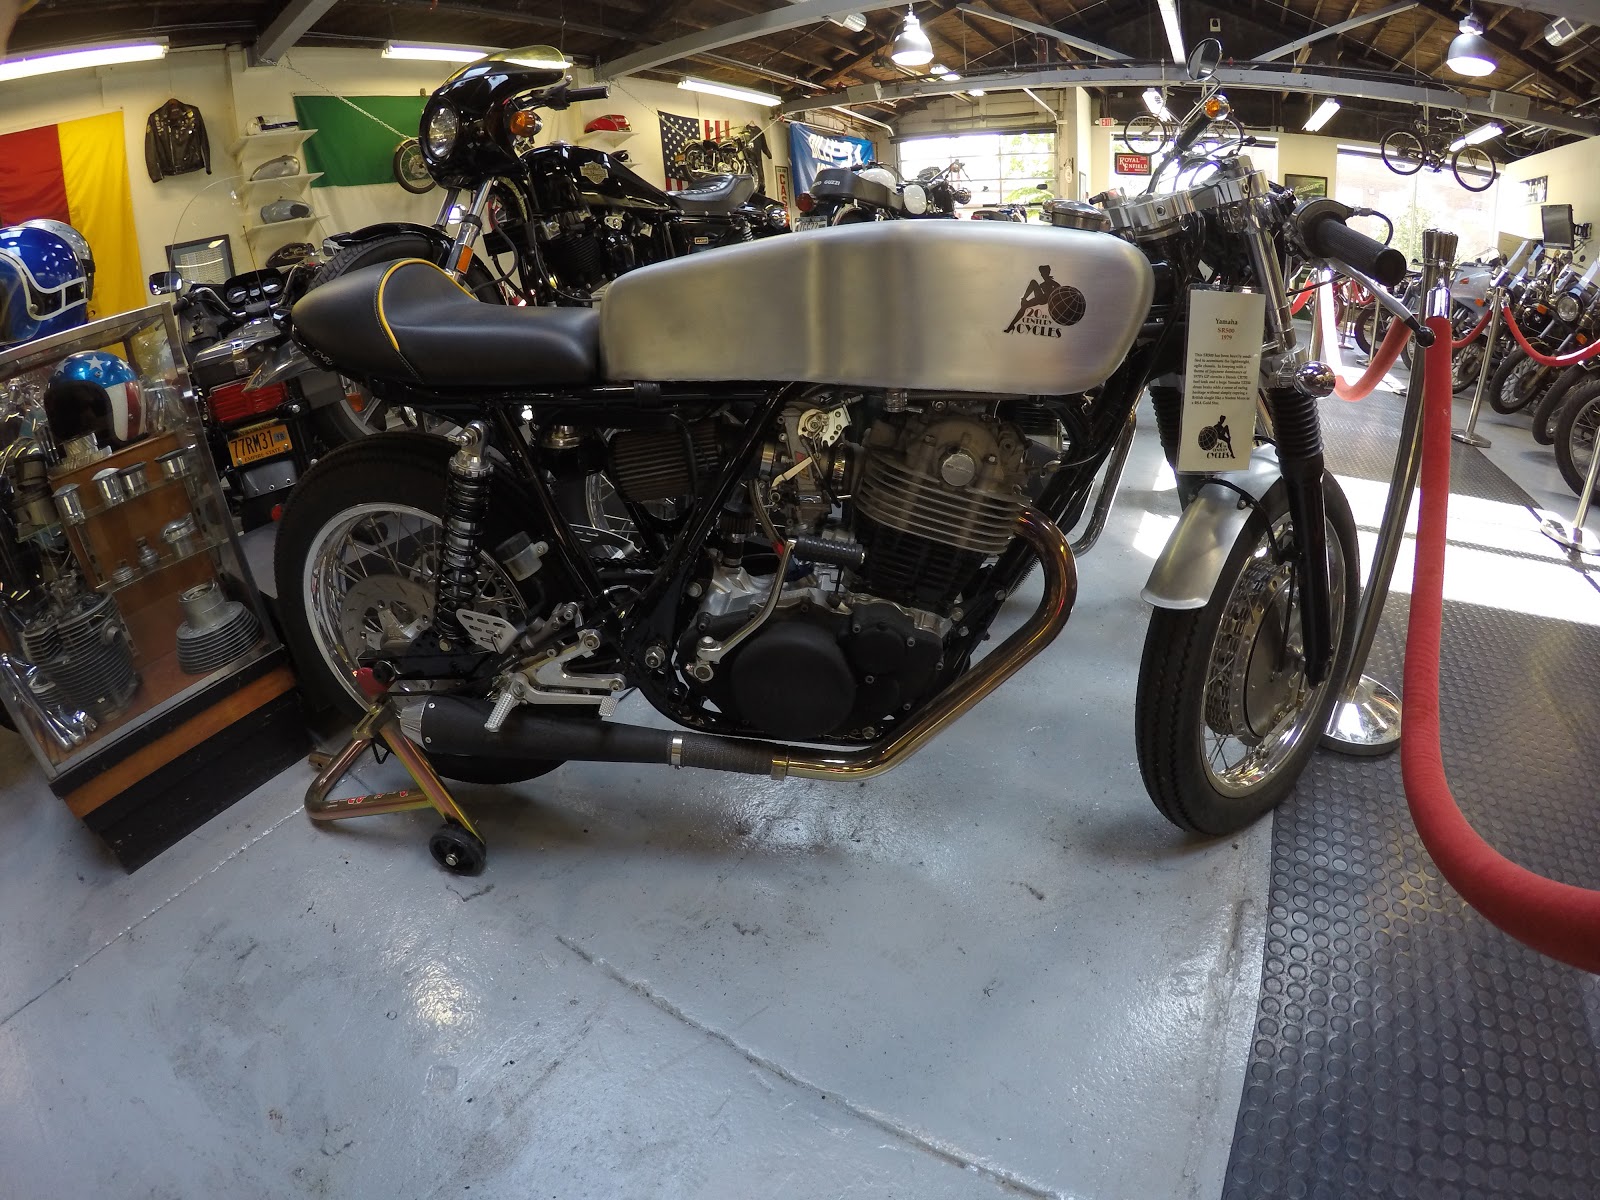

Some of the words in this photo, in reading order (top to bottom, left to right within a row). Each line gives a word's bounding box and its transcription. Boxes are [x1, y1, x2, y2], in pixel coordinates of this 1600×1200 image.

[1101, 118, 1112, 126] EXIT
[1119, 157, 1140, 165] ROYAL
[1123, 163, 1148, 171] ENFIELD
[1016, 323, 1062, 339] CYCLES
[230, 430, 275, 459] 77RM31
[244, 453, 265, 463] EMPIRE
[266, 446, 282, 455] STATE
